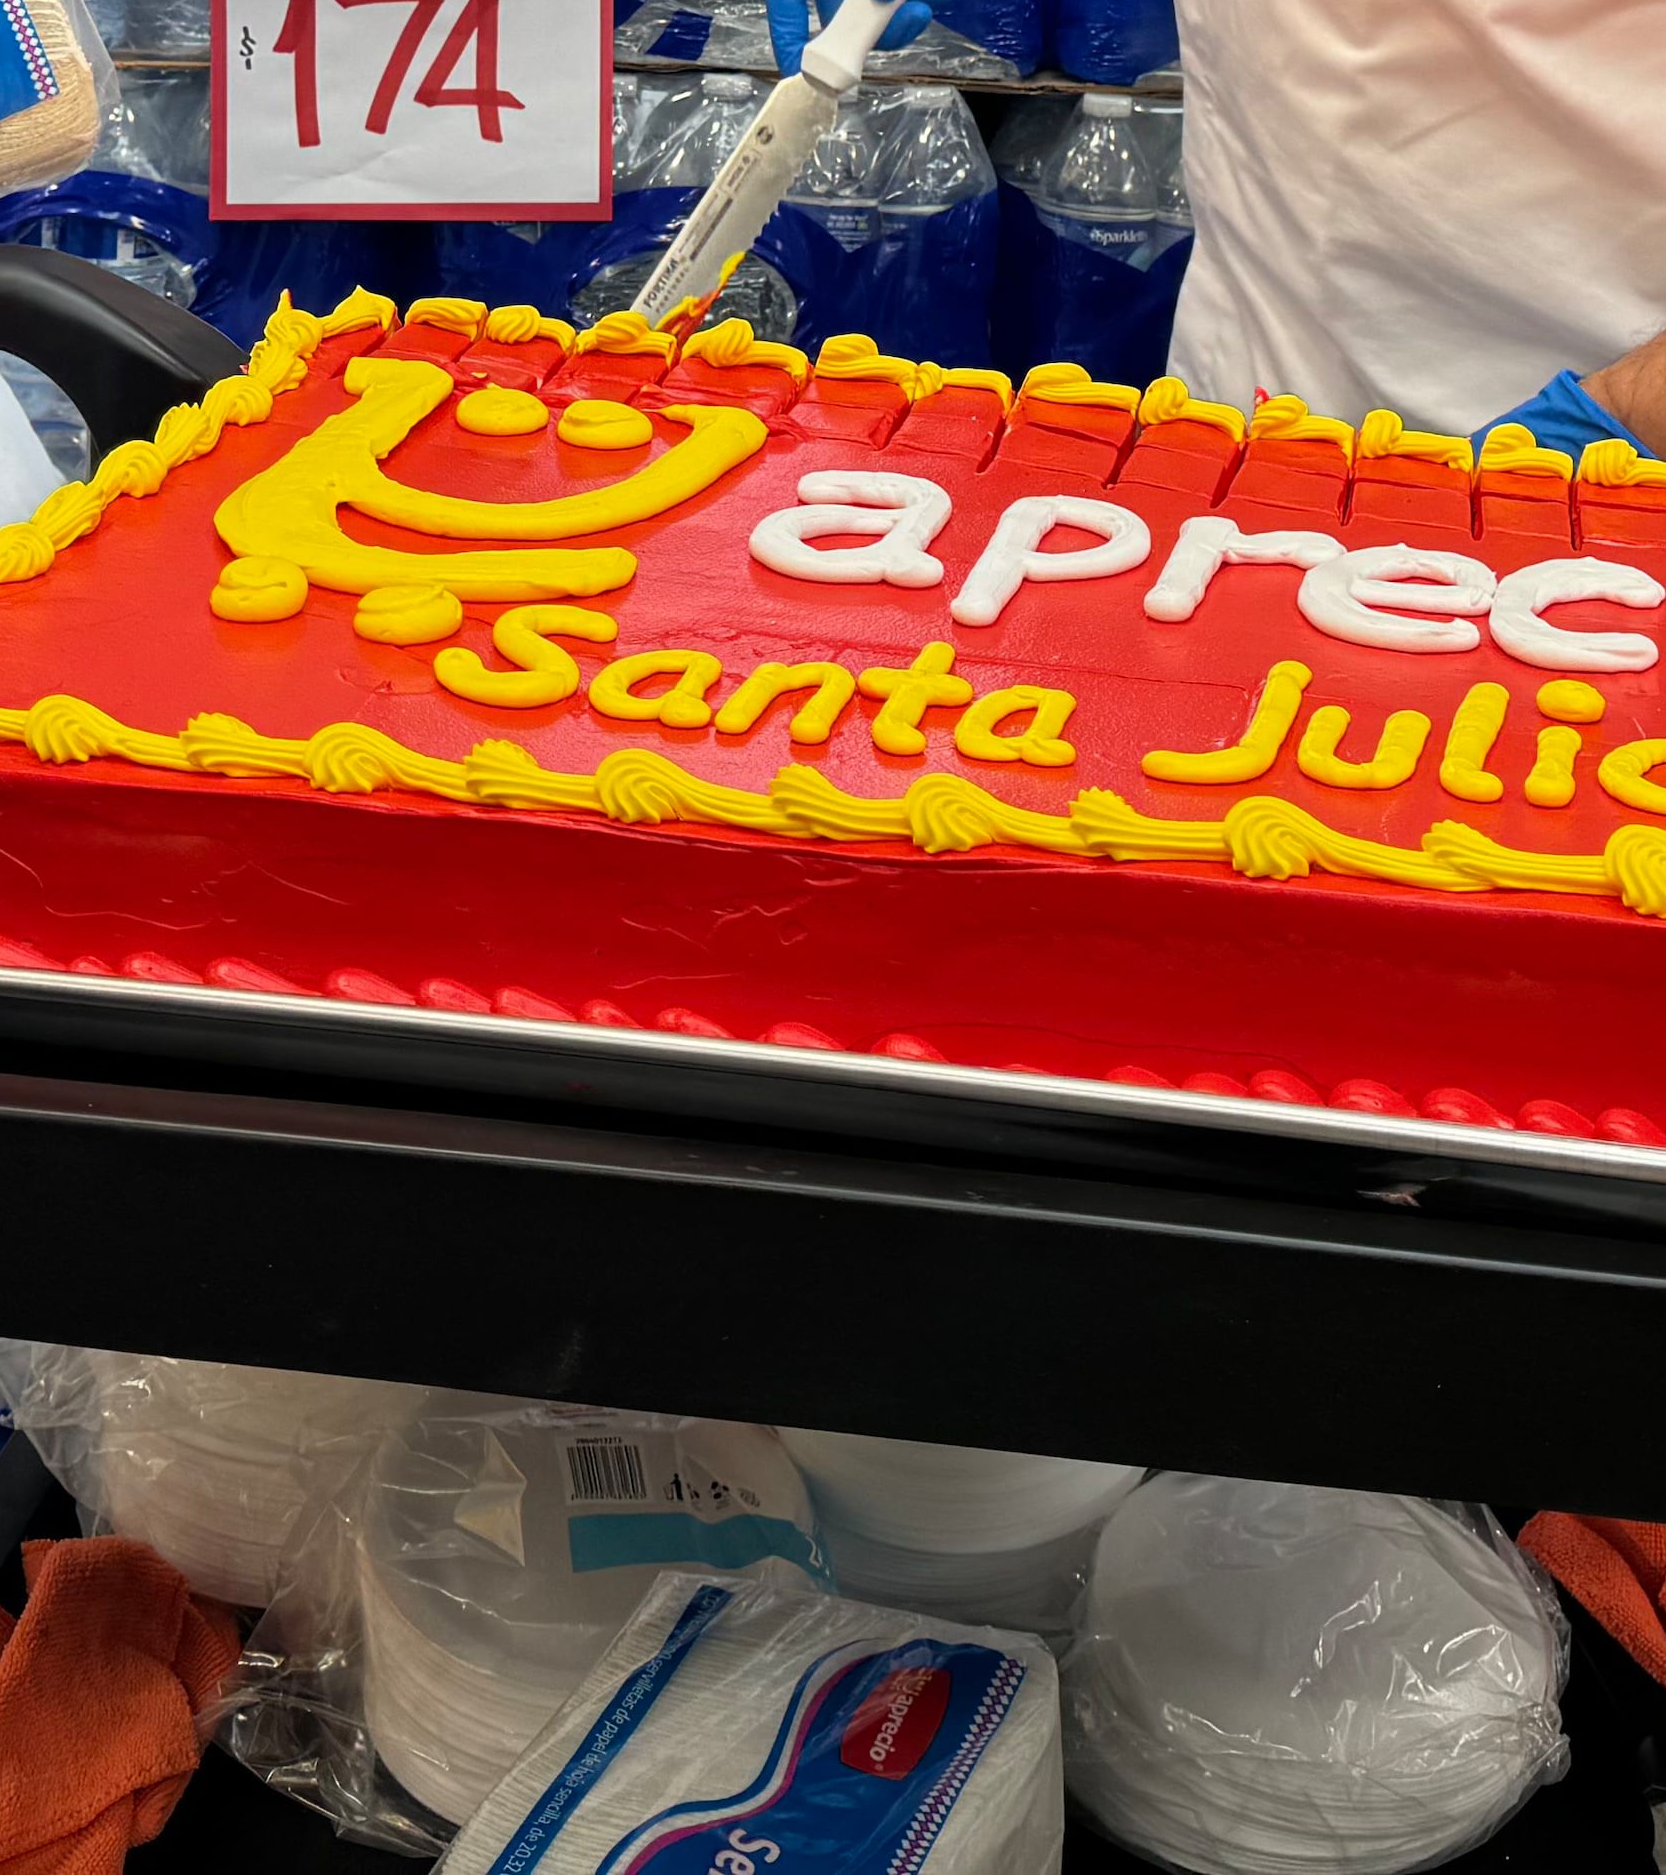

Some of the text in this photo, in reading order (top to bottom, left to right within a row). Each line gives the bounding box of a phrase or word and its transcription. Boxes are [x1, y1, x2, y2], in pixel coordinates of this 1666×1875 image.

[239, 24, 256, 71] $
[429, 600, 1080, 770] Santa
[613, 1707, 631, 1725] de
[869, 1695, 913, 1763] aprecio
[592, 1719, 619, 1754] papel
[582, 1752, 601, 1768] de
[524, 1826, 545, 1842] de
